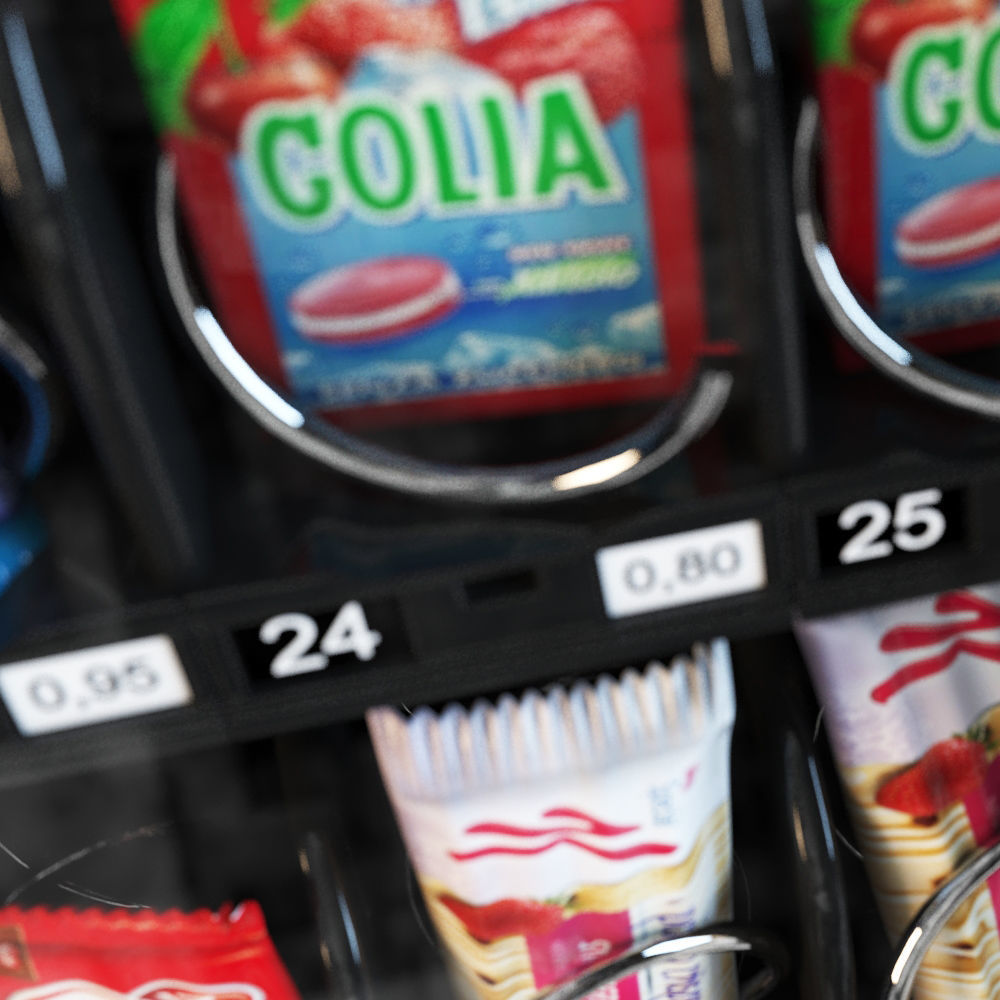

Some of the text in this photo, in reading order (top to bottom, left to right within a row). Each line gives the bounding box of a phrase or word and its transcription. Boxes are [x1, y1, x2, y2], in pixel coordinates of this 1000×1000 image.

[836, 486, 948, 567] 25
[622, 539, 742, 596] 0,80
[258, 599, 383, 680] 24
[26, 655, 160, 713] 0,95
